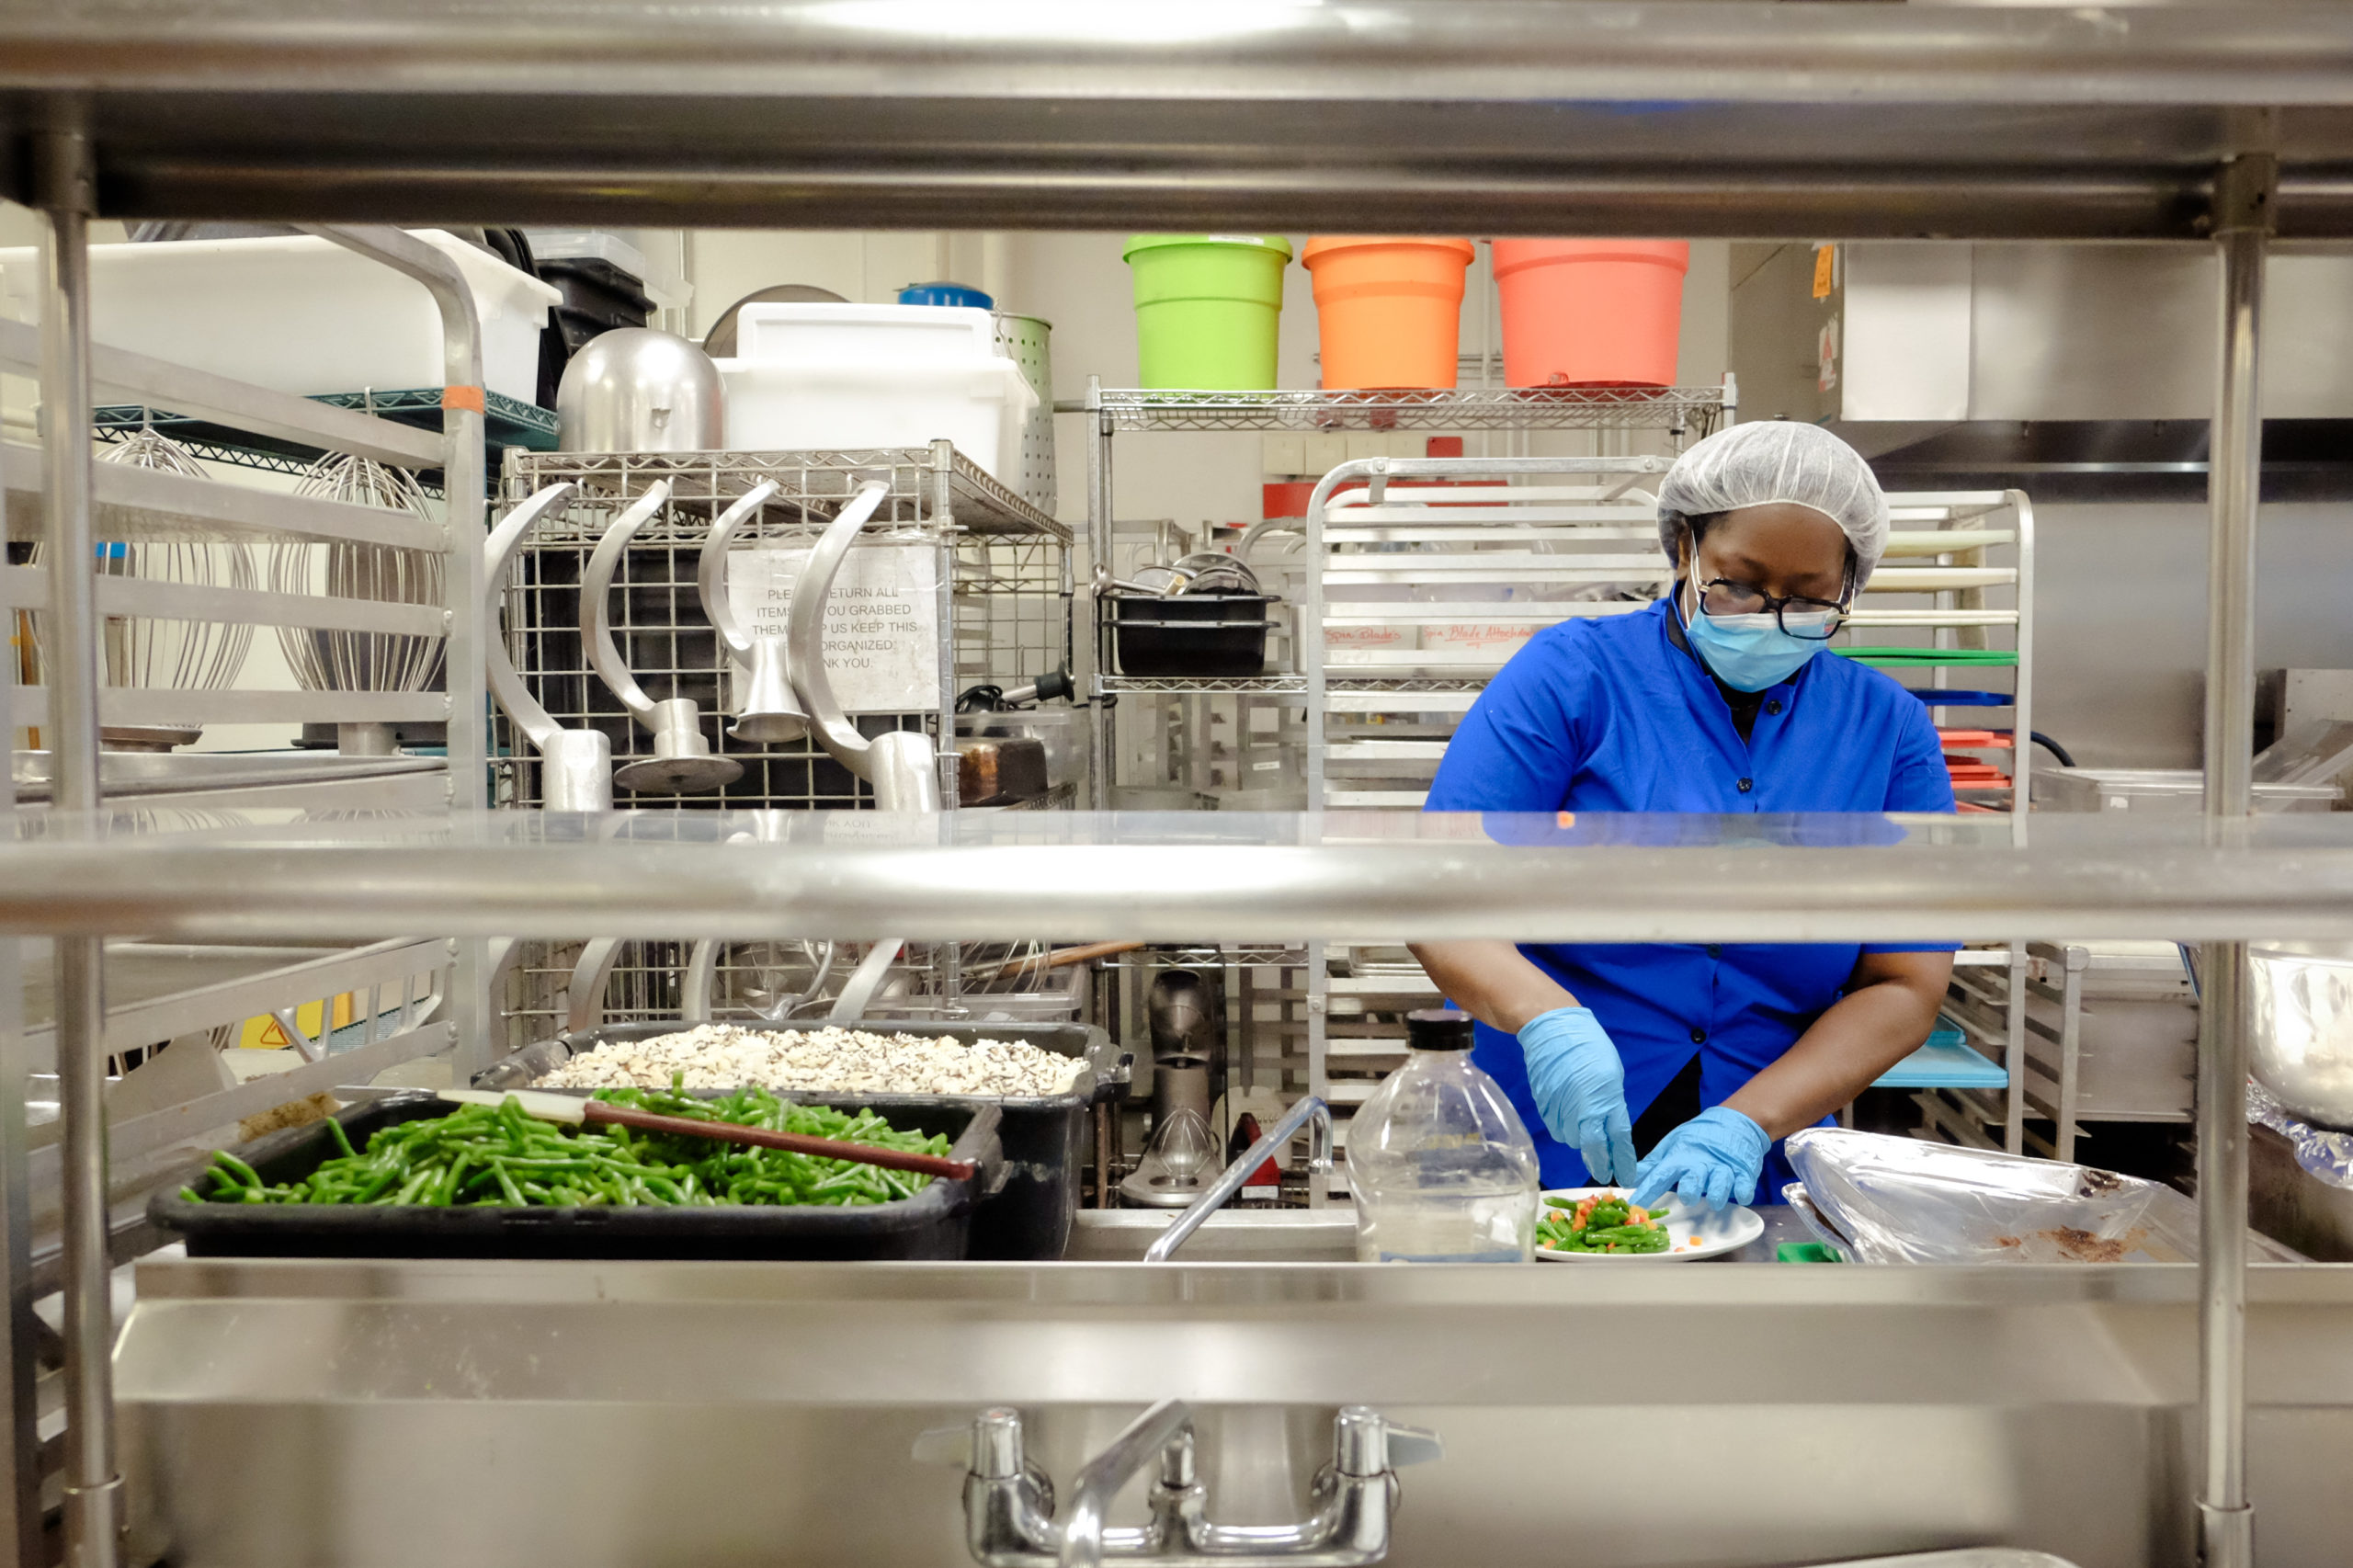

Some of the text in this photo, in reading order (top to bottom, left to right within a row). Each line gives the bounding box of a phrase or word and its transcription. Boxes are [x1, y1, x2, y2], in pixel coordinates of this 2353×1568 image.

[767, 587, 898, 600] PLE ETURN ALL
[827, 605, 846, 617] OU
[848, 604, 912, 616] GRABBED
[830, 623, 847, 634] US
[851, 622, 885, 633] KEEP
[888, 621, 917, 632] THIS
